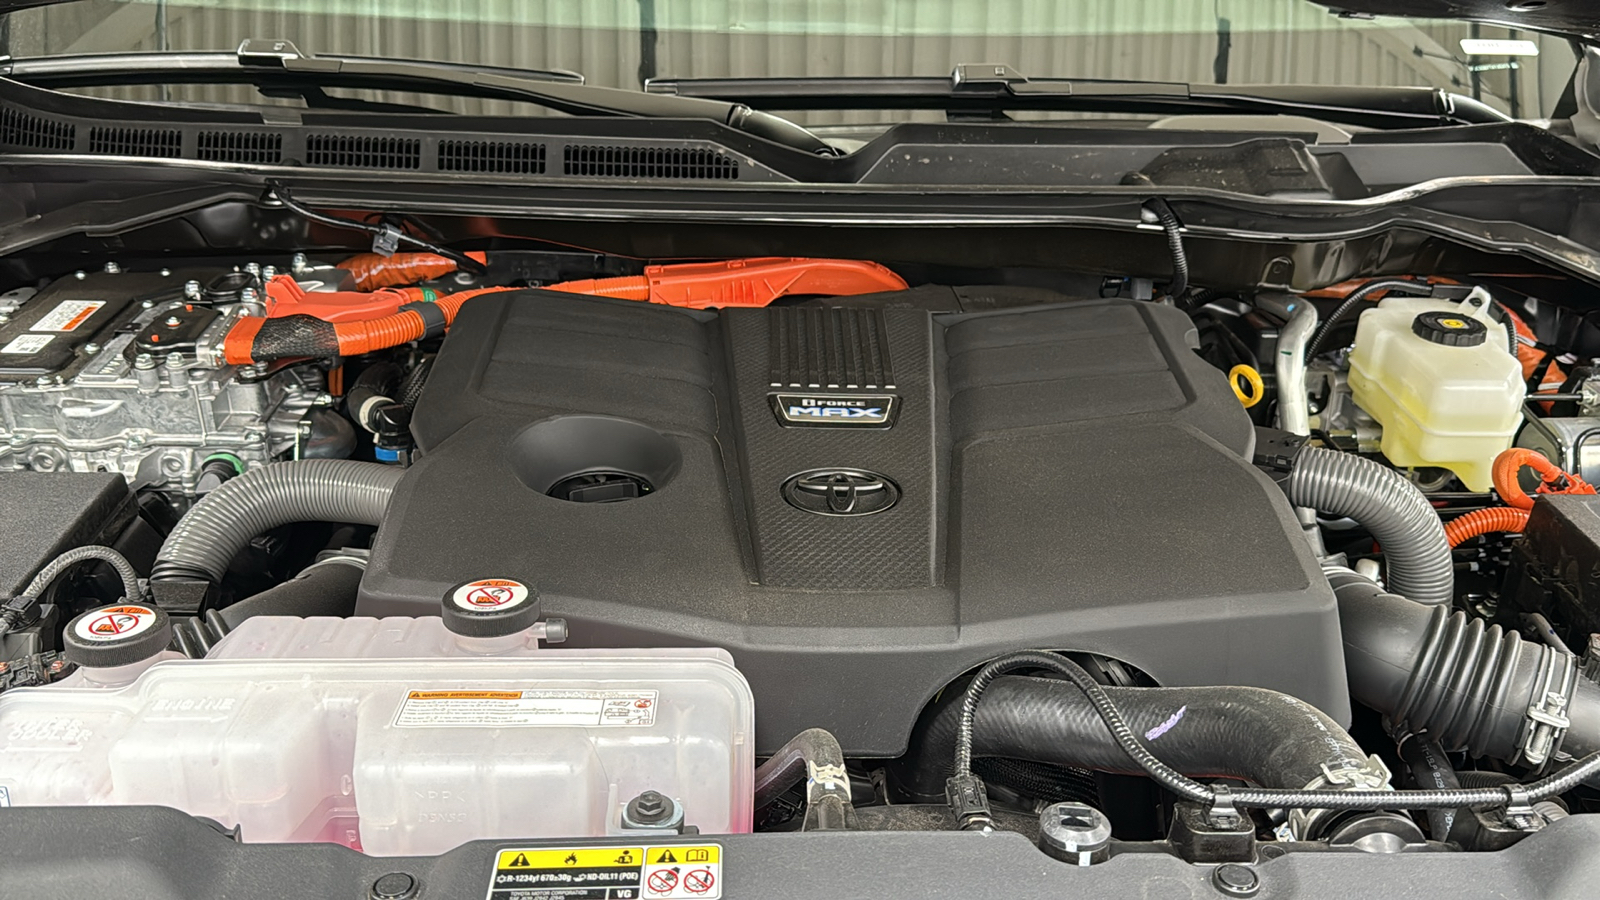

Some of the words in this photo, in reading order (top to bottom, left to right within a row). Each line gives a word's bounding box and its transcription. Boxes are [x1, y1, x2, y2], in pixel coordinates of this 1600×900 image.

[789, 406, 882, 417] MAX
[619, 872, 639, 881] (POE)
[617, 889, 632, 898] VG
